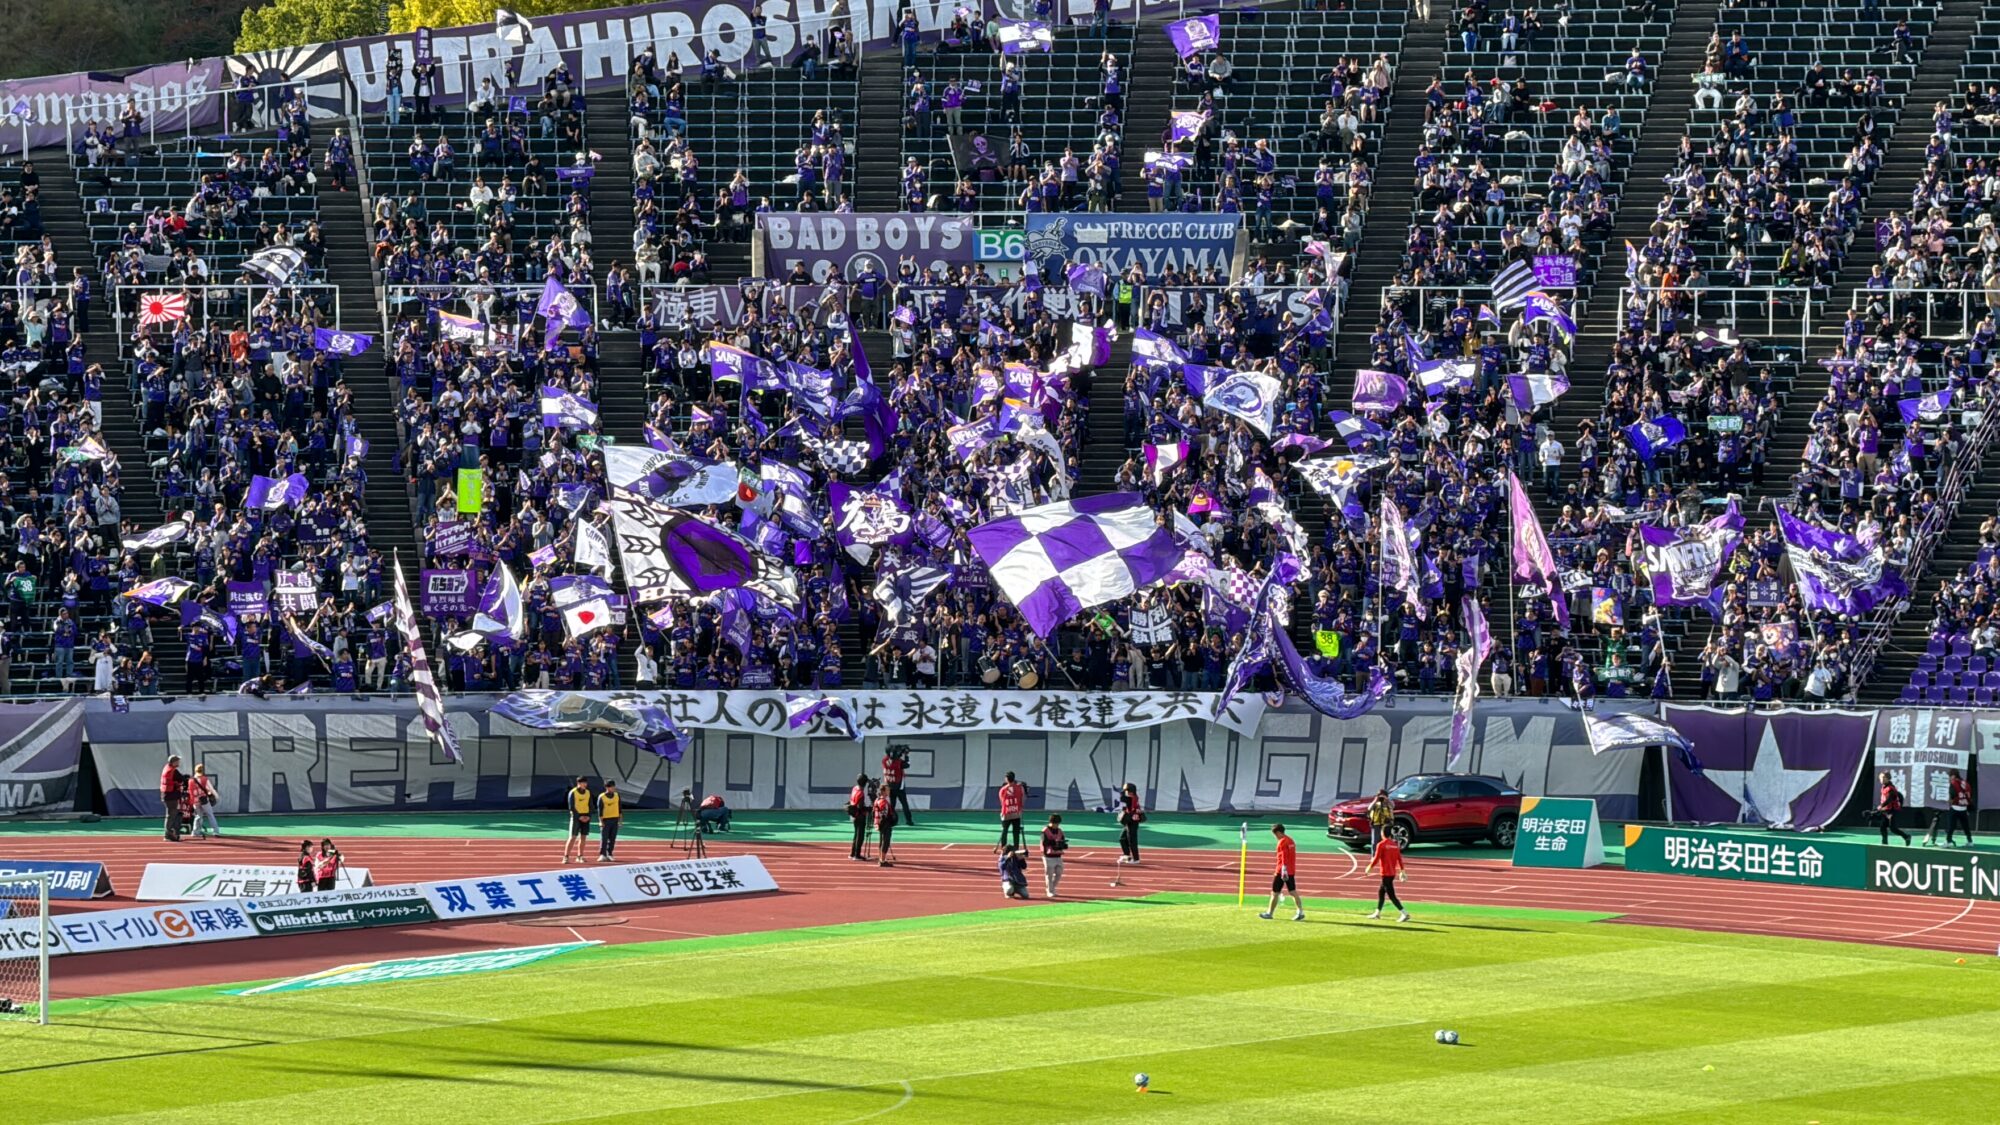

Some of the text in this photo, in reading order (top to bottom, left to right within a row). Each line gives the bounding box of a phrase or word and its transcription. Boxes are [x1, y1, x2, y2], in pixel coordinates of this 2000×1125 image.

[768, 217, 963, 250] BAD BOYS
[1187, 222, 1235, 240] CLUB
[980, 233, 1024, 262] B6
[1072, 247, 1232, 278] OKAYAMA
[277, 571, 312, 587] 広島
[280, 594, 318, 611] 共闘
[1889, 714, 1960, 746] 勝利
[1914, 751, 1959, 765] HIROSHIMA
[1522, 817, 1586, 835] 明治安田
[1534, 835, 1567, 852] 生命
[1664, 836, 1824, 879] 明治安田生命
[660, 868, 745, 895] 戸田工業
[1875, 860, 1964, 893] ROUTE
[436, 874, 596, 913] 双葉工業
[274, 908, 354, 927] Hibrid-Turf
